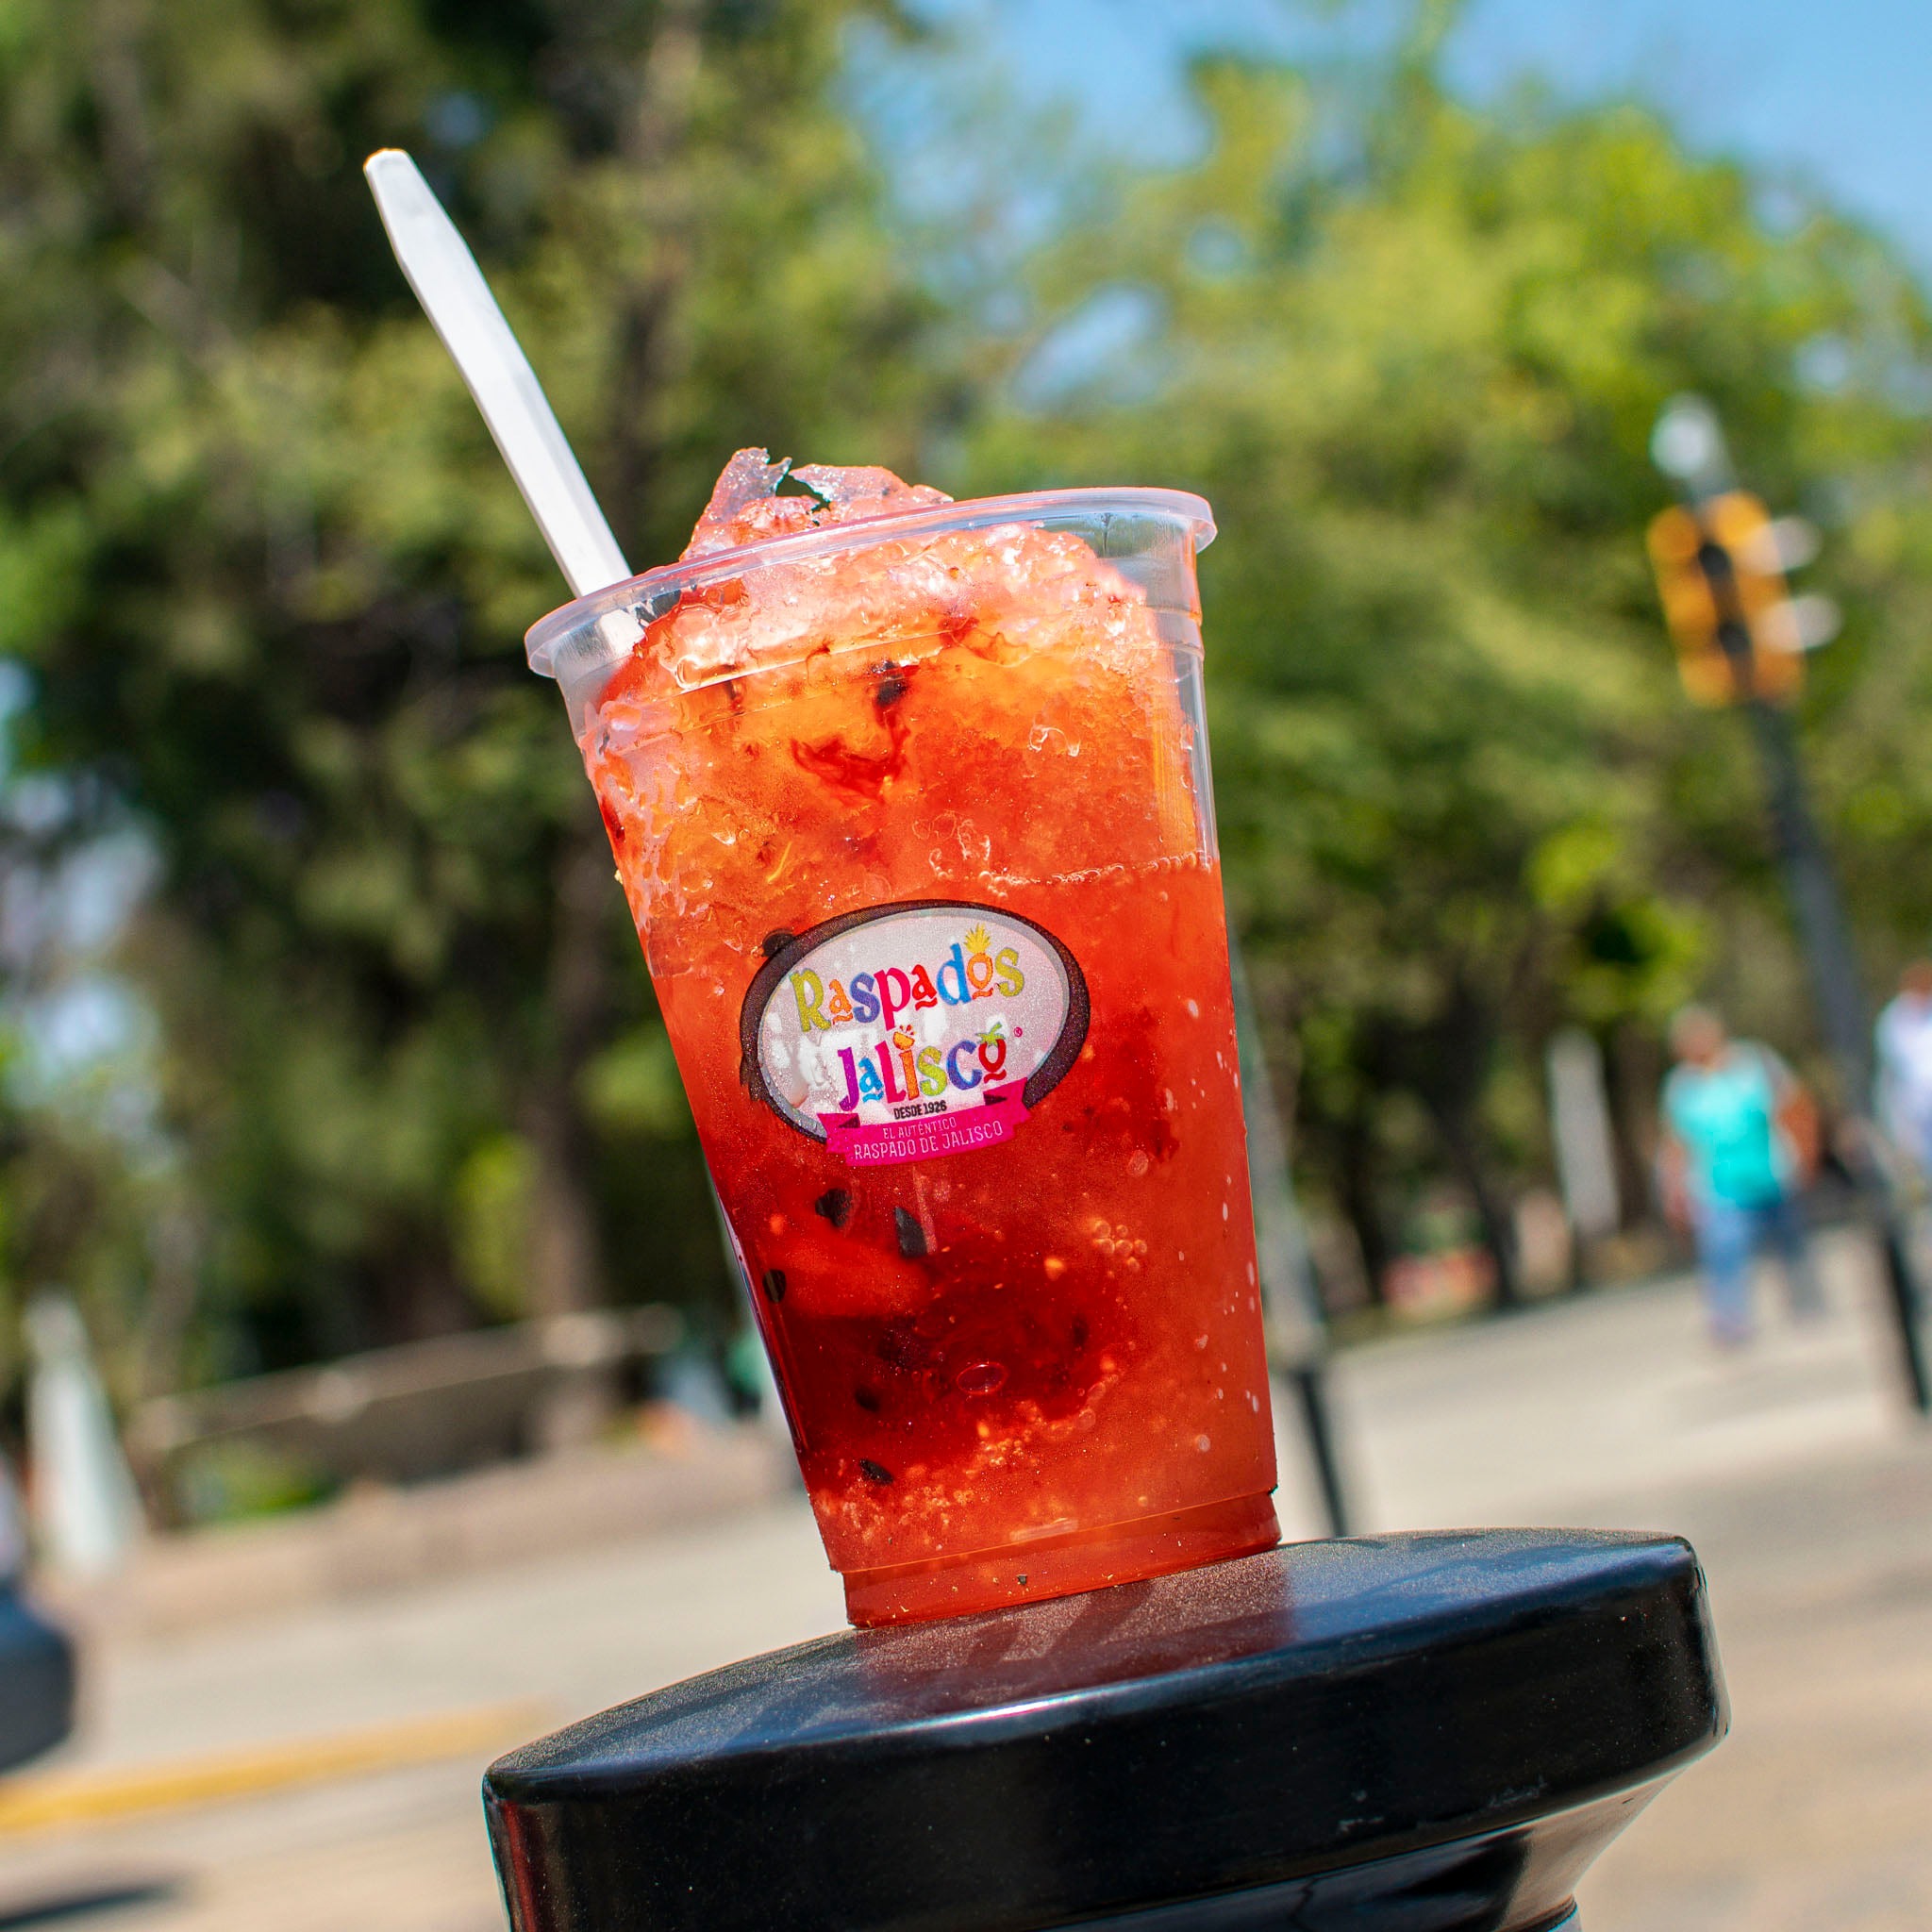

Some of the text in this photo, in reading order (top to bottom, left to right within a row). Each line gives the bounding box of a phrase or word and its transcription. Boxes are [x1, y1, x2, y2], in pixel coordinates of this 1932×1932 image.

[790, 941, 1025, 1033] Raspados
[893, 1100, 947, 1120] DESDE 1926
[854, 1120, 1004, 1159] RASPADO DE JALISCO
[882, 1117, 957, 1140] EL AUTÉNTICO
